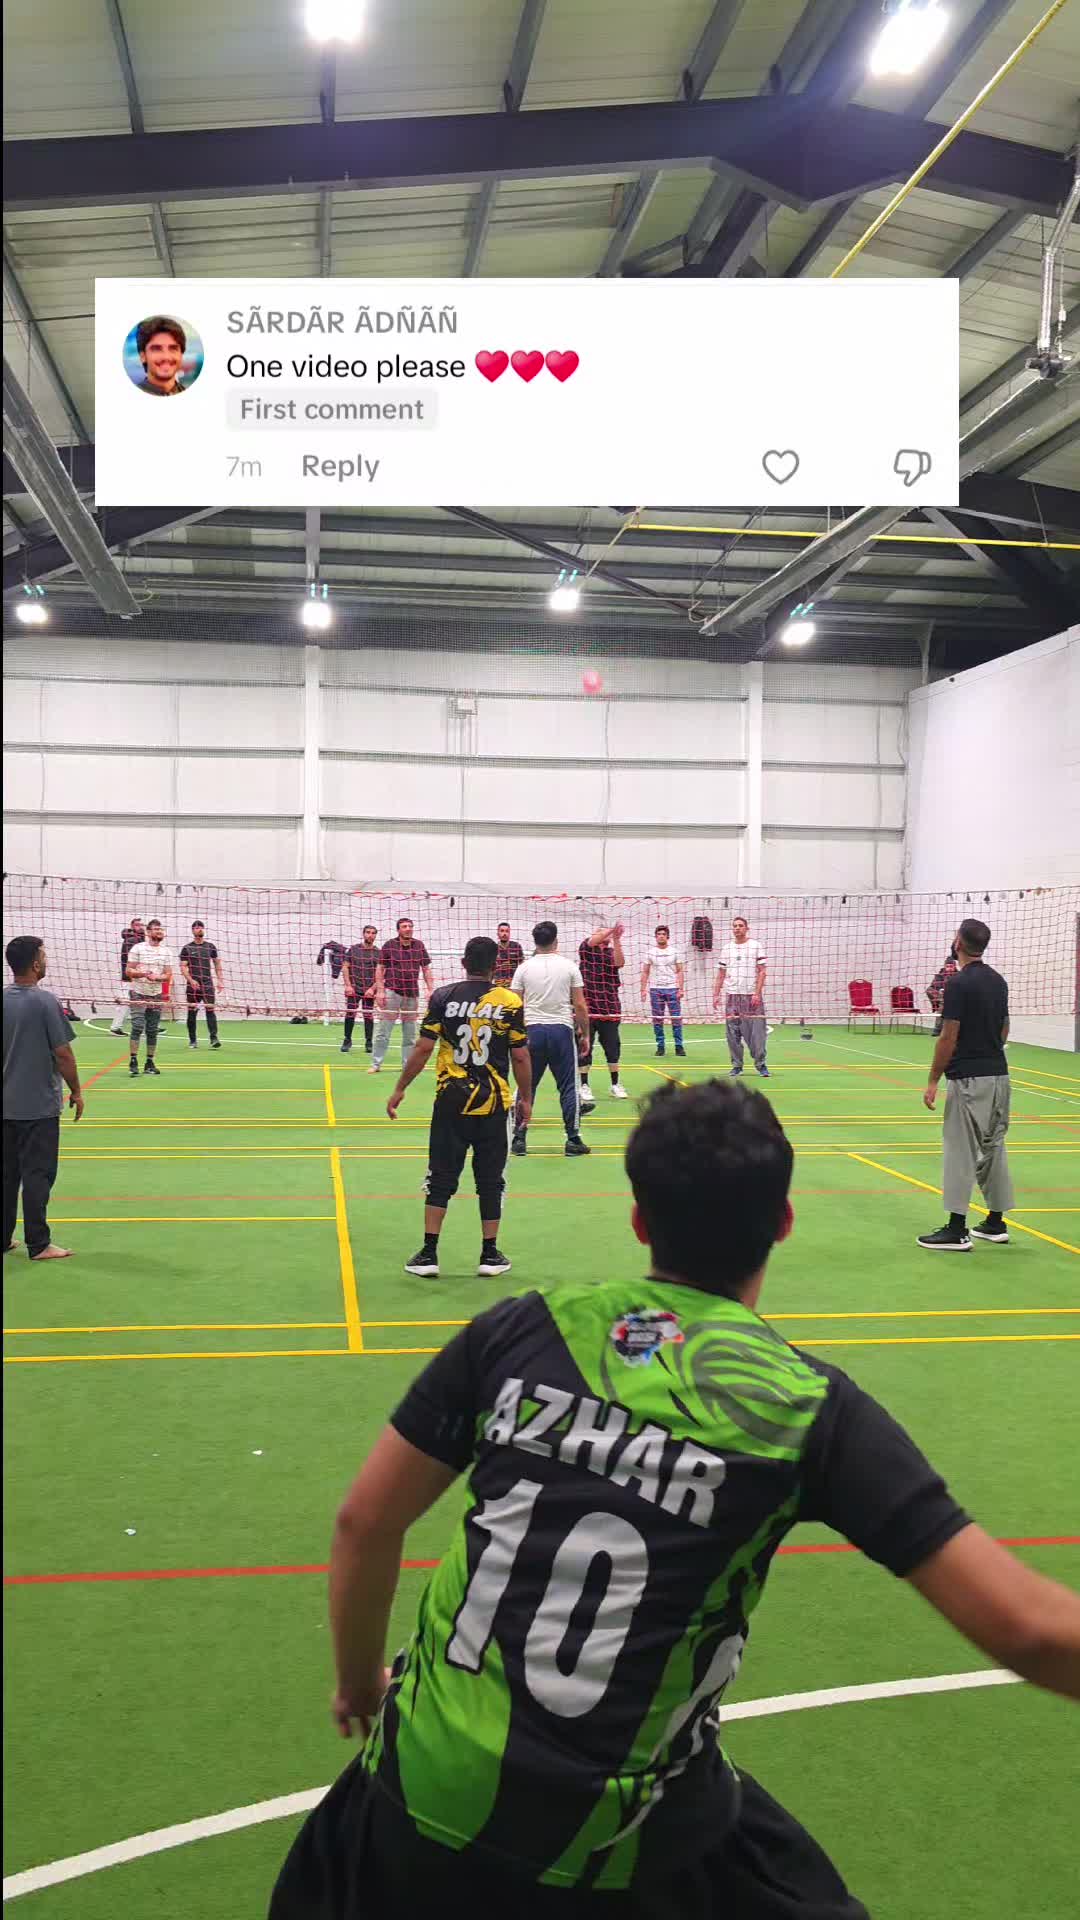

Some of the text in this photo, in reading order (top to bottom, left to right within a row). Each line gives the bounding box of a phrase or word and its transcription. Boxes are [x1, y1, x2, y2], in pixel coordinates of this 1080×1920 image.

[444, 1001, 506, 1020] BILAL
[453, 1024, 492, 1066] 33
[484, 1377, 727, 1528] AZHAR
[447, 1478, 649, 1718] 10
